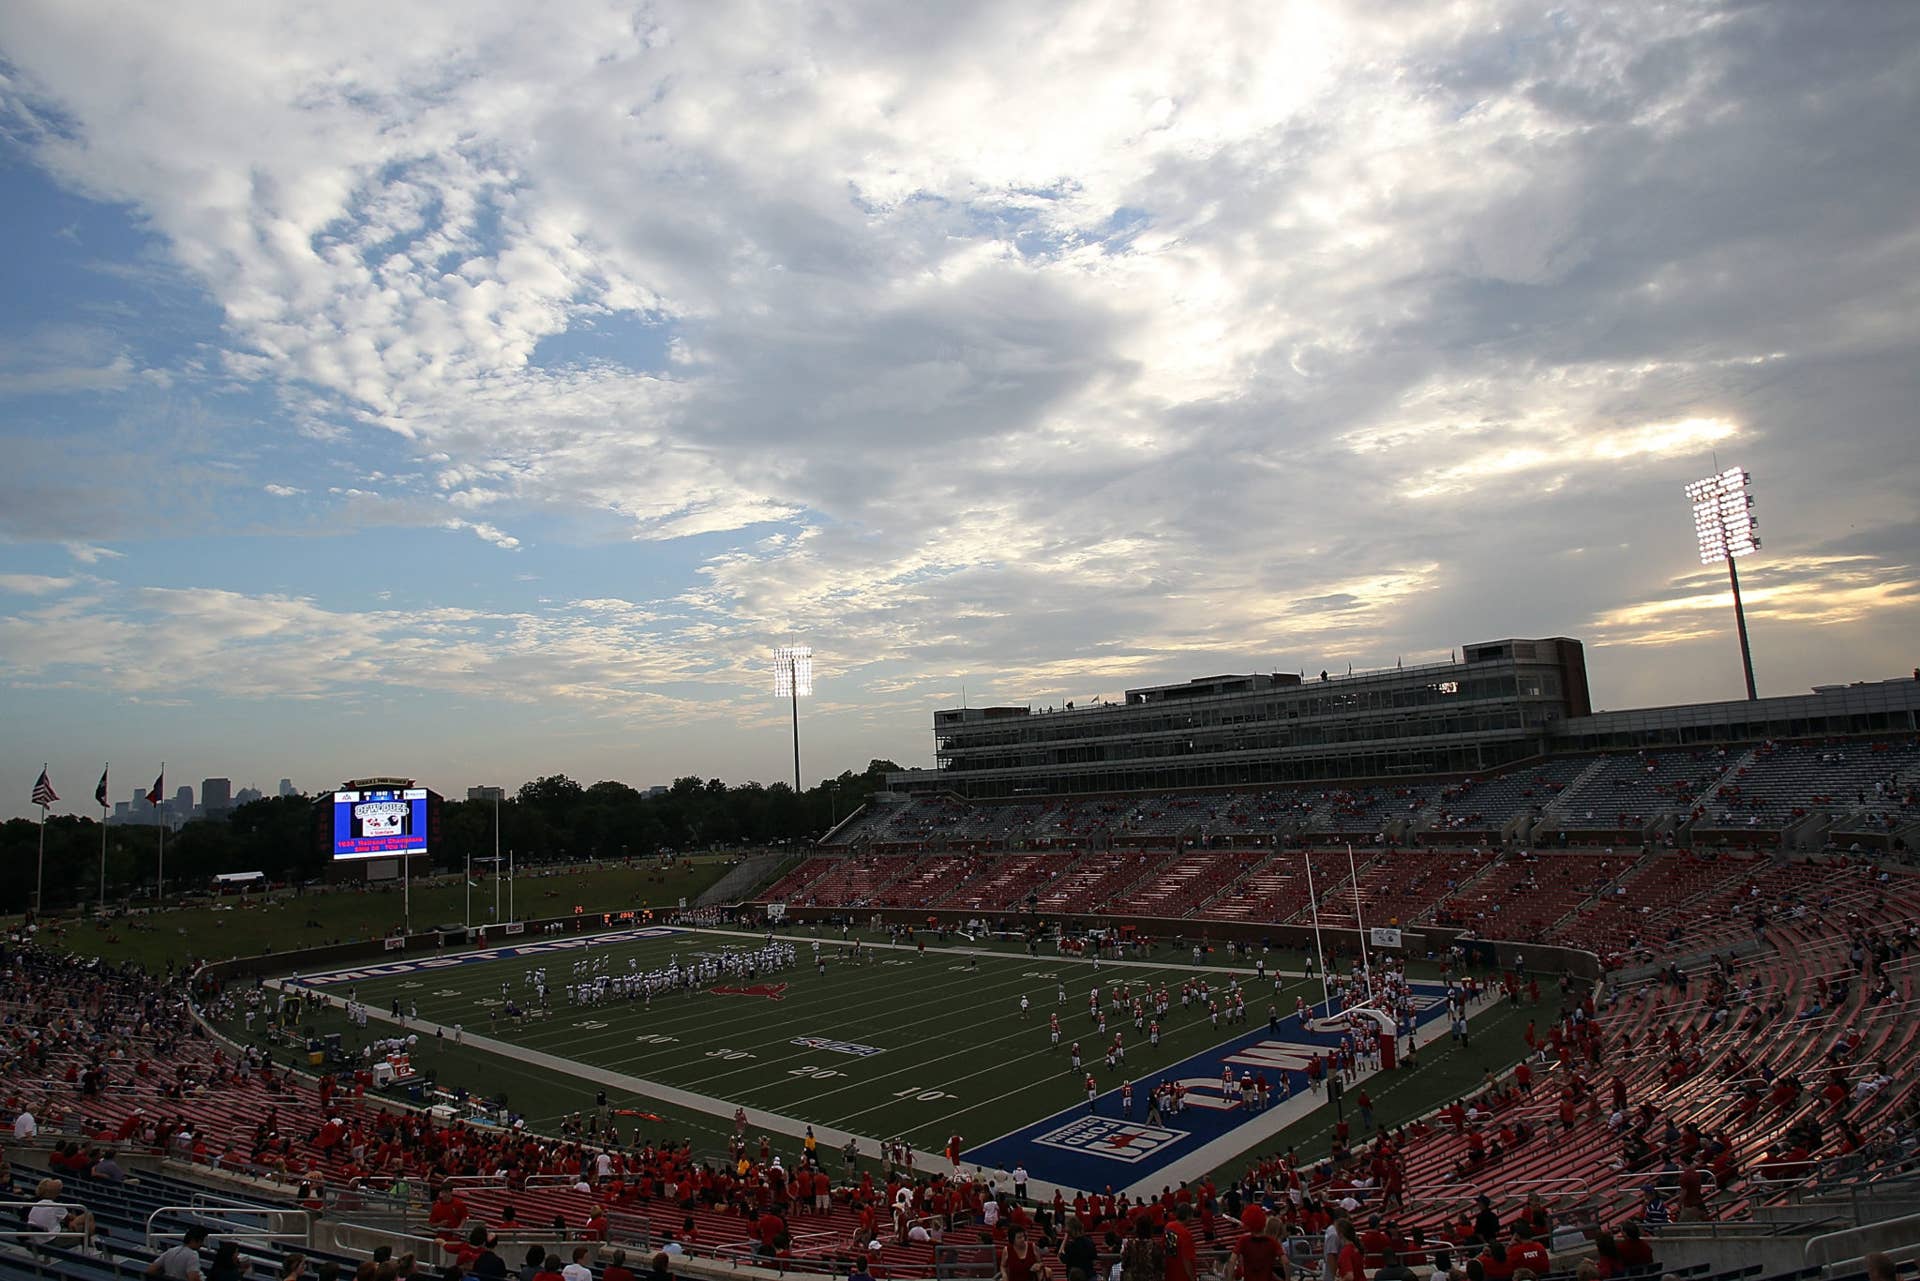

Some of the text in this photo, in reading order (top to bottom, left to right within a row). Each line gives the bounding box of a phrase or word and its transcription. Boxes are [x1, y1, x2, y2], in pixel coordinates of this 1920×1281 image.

[704, 1048, 751, 1061] 30
[787, 1065, 840, 1079] 20
[892, 1087, 946, 1101] 10
[1064, 1122, 1121, 1146] FORD
